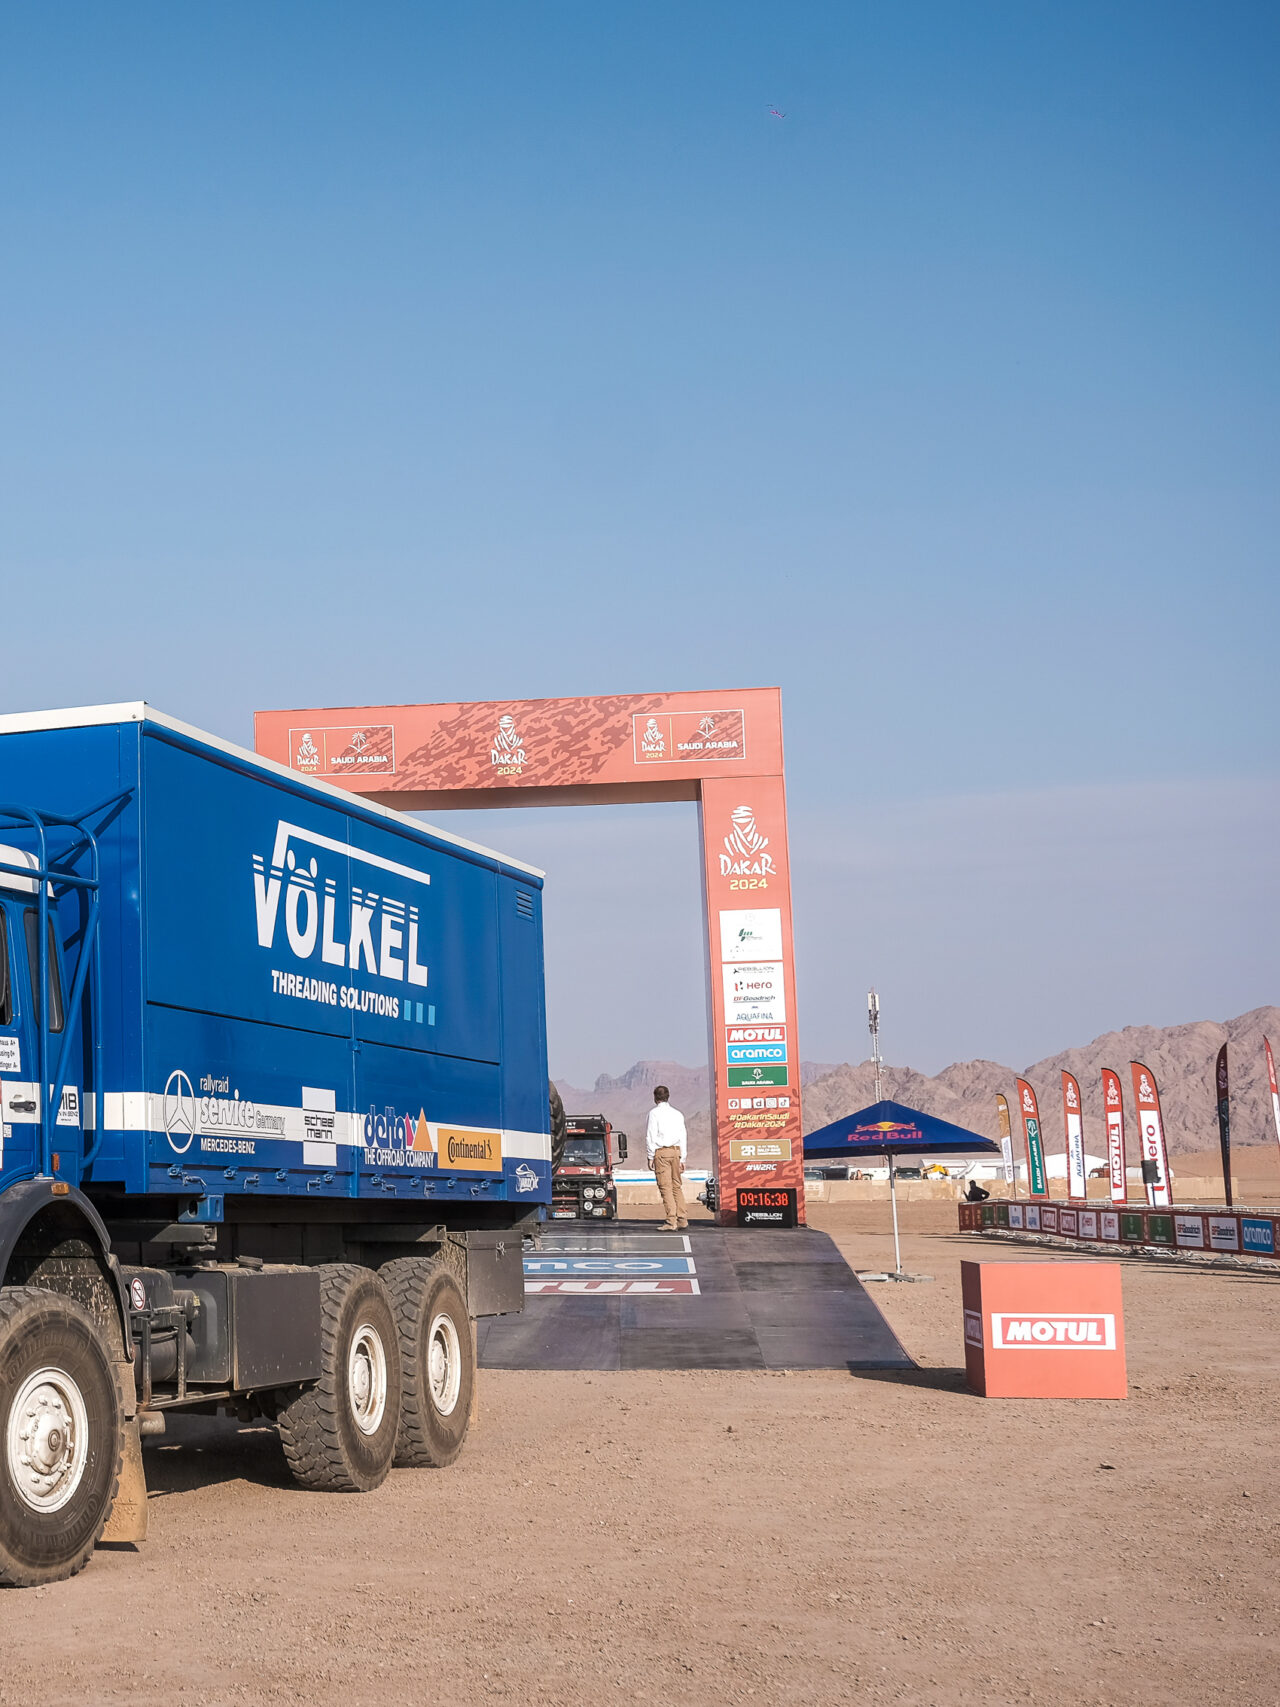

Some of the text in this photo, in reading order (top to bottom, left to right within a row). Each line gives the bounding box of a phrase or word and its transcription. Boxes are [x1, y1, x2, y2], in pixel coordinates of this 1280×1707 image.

[641, 741, 666, 752] DAKAR
[704, 741, 738, 749] ARABIA
[297, 754, 320, 766] DAKAR
[331, 755, 388, 764] SAUDI ARABIA
[491, 749, 528, 765] DAKAR
[497, 766, 523, 775] 2024
[718, 853, 776, 876] DAKAR
[729, 878, 768, 890] 2024
[252, 820, 430, 987] VÖLKEL
[272, 969, 398, 1018] THREADING SOLUTIONS
[736, 1012, 774, 1022] AQUAFINA
[730, 1028, 783, 1041] MOTUL
[731, 1048, 782, 1058] aramco
[200, 1074, 229, 1096] rallyraid
[200, 1088, 286, 1134] service Germany
[729, 1112, 790, 1120] #DakarInSaudi
[364, 1104, 406, 1150] delta
[734, 1120, 786, 1128] #Dakar2024
[307, 1128, 332, 1140] mann
[848, 1131, 922, 1142] Red Bull
[200, 1138, 256, 1154] MERCEDES-BENZ
[448, 1136, 487, 1164] Continental
[1146, 1124, 1159, 1168] ero
[364, 1148, 434, 1168] THE OFFROAD COMPANY
[1110, 1126, 1122, 1185] MOTUL
[740, 1192, 788, 1206] 09:16:38
[1244, 1226, 1271, 1244] aramco
[523, 1262, 663, 1270] mco
[524, 1282, 675, 1293] TUL
[1006, 1321, 1102, 1342] MOTUL
